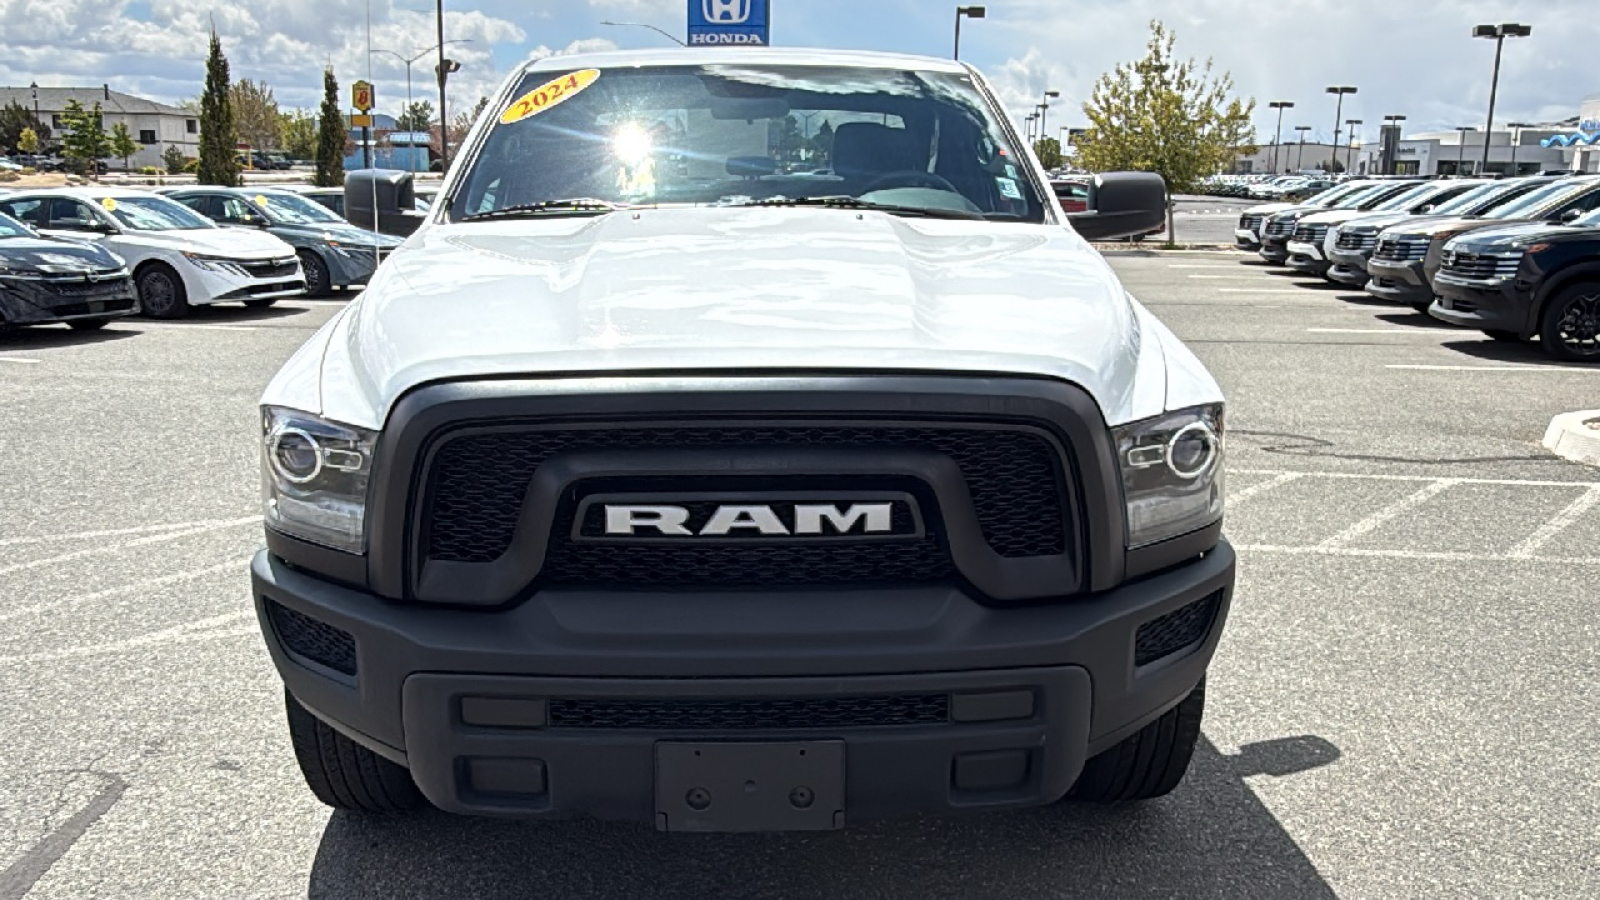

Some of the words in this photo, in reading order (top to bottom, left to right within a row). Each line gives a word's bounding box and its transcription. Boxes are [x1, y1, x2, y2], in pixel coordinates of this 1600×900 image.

[691, 33, 763, 45] HONDA
[516, 75, 577, 117] 2024
[604, 503, 893, 535] RAM
